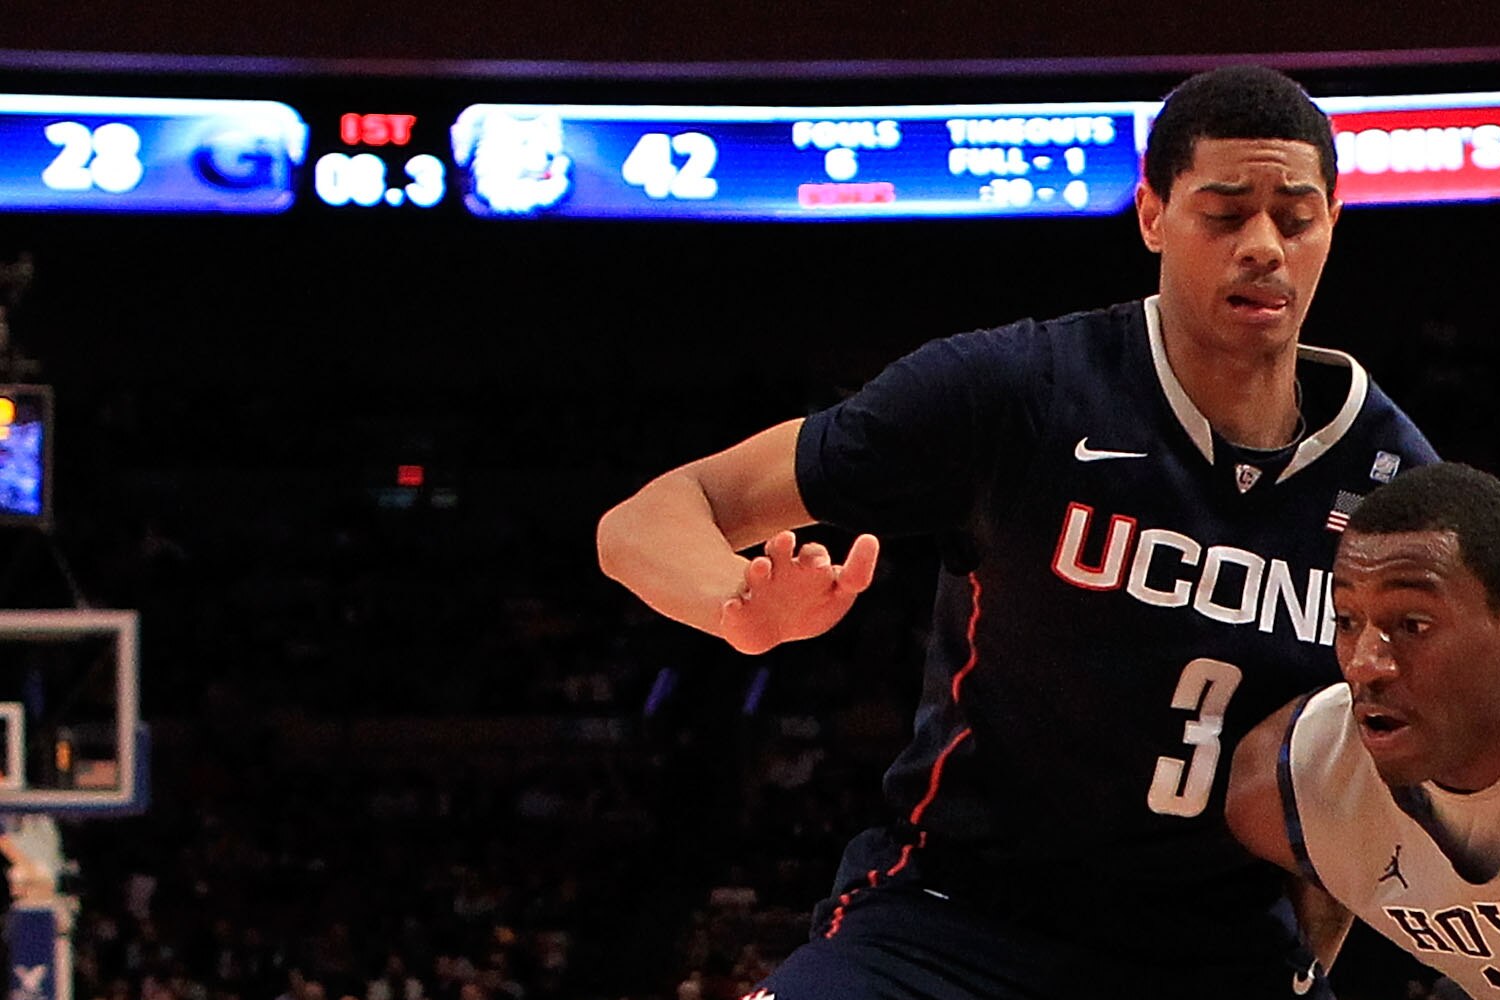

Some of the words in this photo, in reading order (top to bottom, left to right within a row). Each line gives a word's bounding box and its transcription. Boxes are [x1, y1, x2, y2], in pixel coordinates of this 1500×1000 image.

[792, 120, 900, 149] FOULS
[946, 117, 1116, 146] TIMEOUTS
[42, 121, 142, 192] 28
[622, 132, 718, 200] 42
[949, 147, 1030, 175] FULL
[1147, 657, 1242, 818] 3
